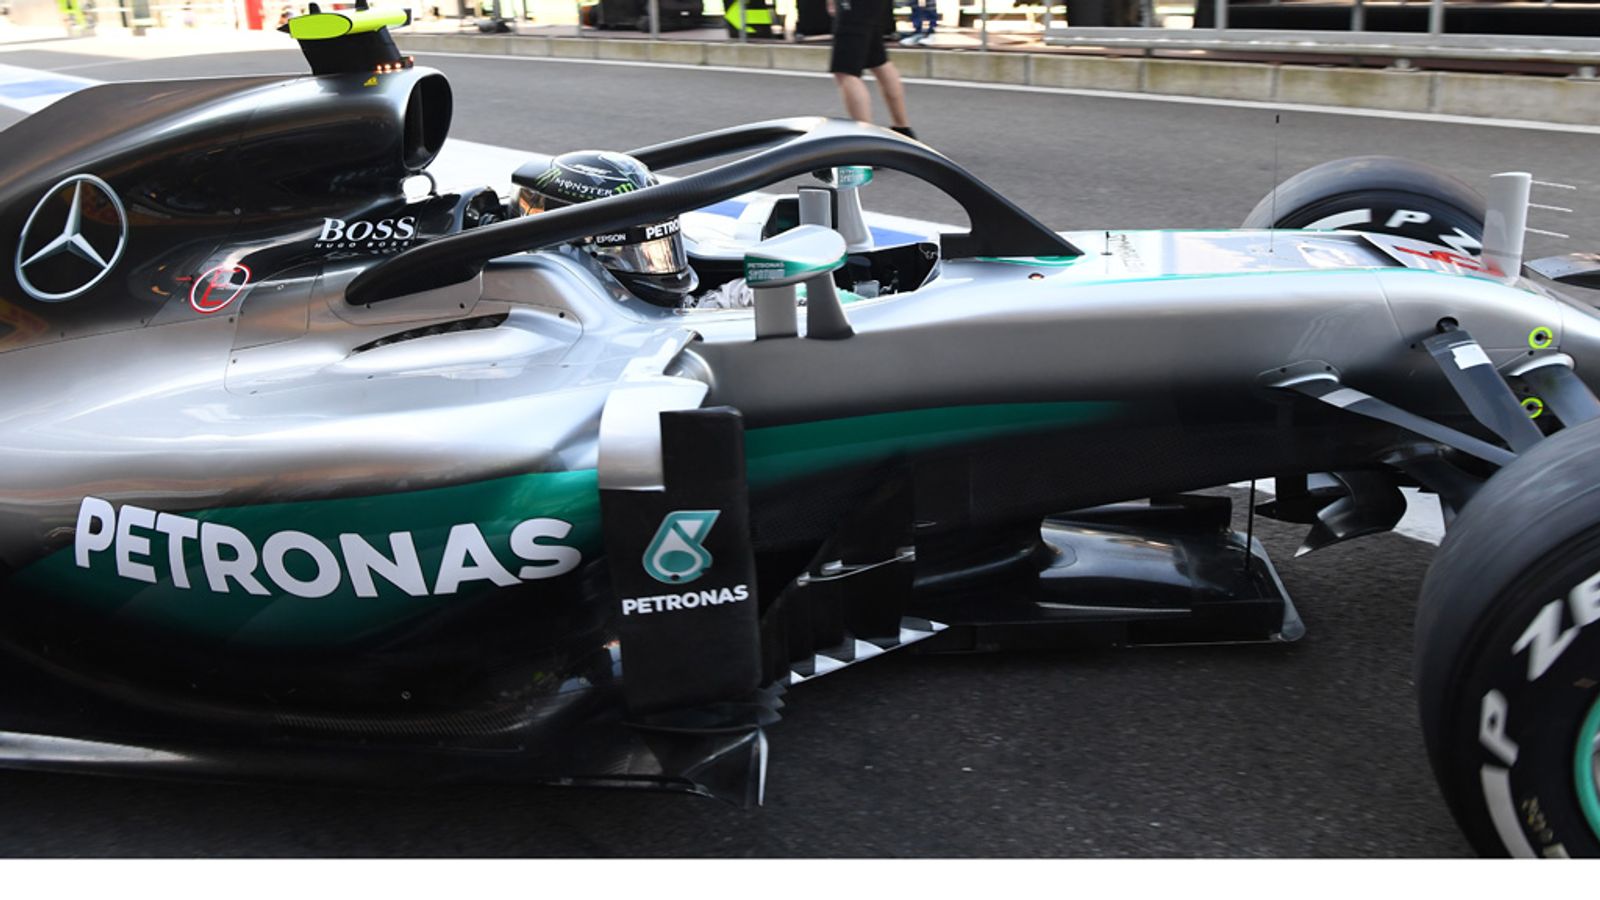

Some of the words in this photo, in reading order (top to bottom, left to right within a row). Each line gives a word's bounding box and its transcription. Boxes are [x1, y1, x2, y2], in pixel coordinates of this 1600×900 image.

[318, 216, 415, 241] BOSS
[1384, 209, 1432, 228] P
[75, 496, 582, 598] PETRONAS
[622, 585, 749, 615] PETRONAS
